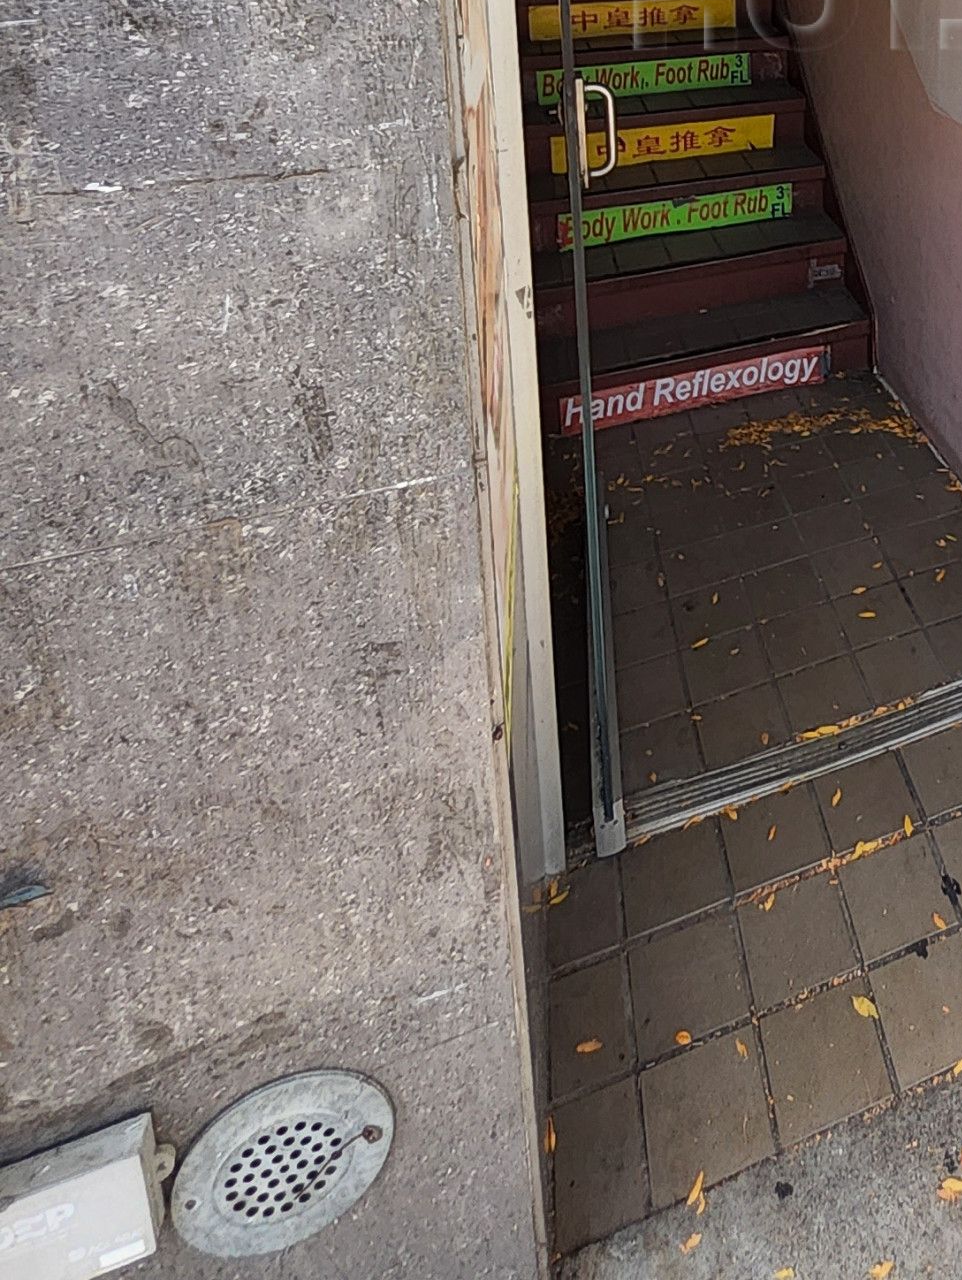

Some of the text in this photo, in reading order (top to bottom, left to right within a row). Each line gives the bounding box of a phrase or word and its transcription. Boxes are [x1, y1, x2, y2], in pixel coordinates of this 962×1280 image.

[655, 61, 694, 87] Foot
[697, 57, 730, 83] Rub
[735, 55, 744, 68] 3
[730, 69, 749, 85] FL
[622, 205, 672, 233] Work
[687, 197, 729, 224] Foot
[733, 189, 769, 217] Rub
[776, 186, 785, 200] 3
[770, 203, 791, 220] FL
[564, 356, 819, 428] Hand Reflexology
